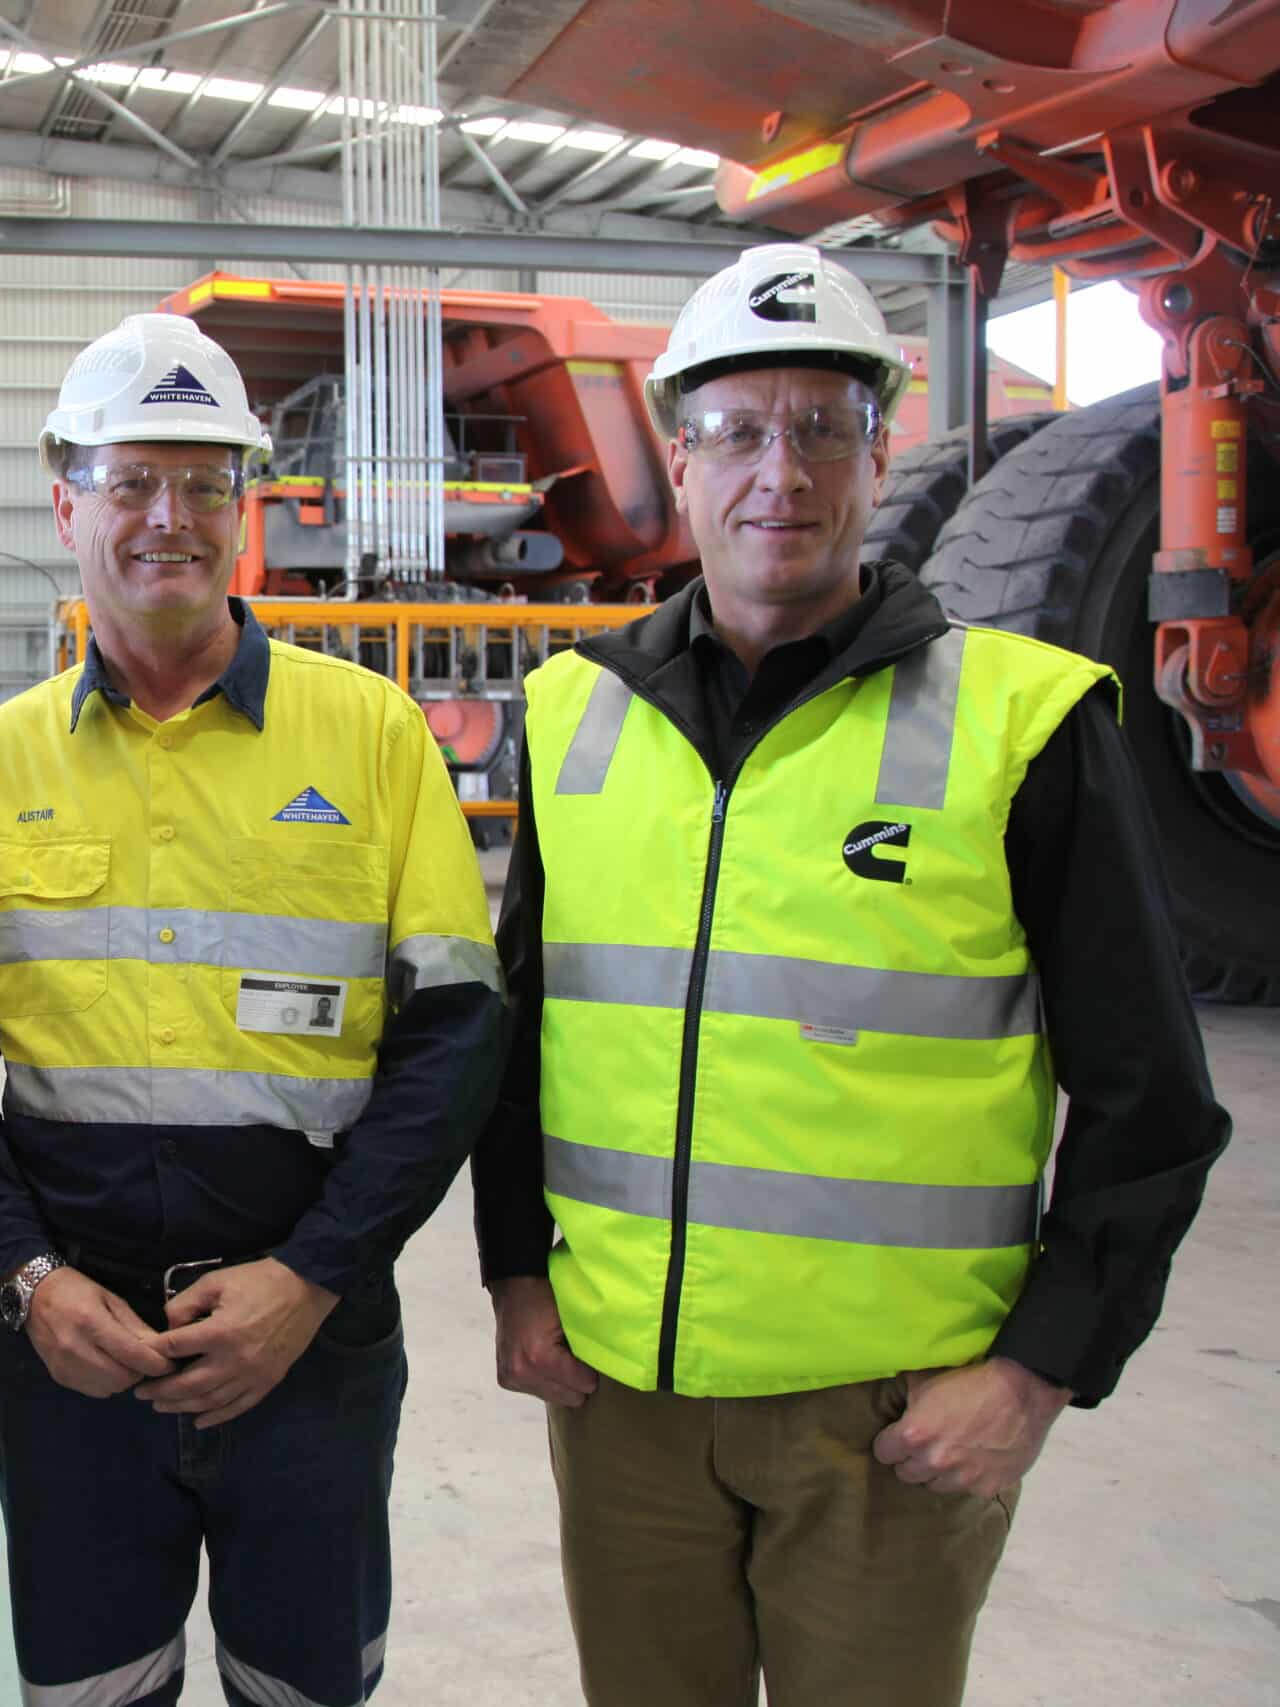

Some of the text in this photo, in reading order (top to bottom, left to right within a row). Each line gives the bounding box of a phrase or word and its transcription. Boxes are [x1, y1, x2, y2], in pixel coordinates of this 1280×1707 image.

[150, 393, 211, 403] WHITEHAVEN
[17, 808, 54, 823] ALISTAIR
[282, 812, 340, 822] WHITEHAVEN
[844, 824, 907, 855] Cummins
